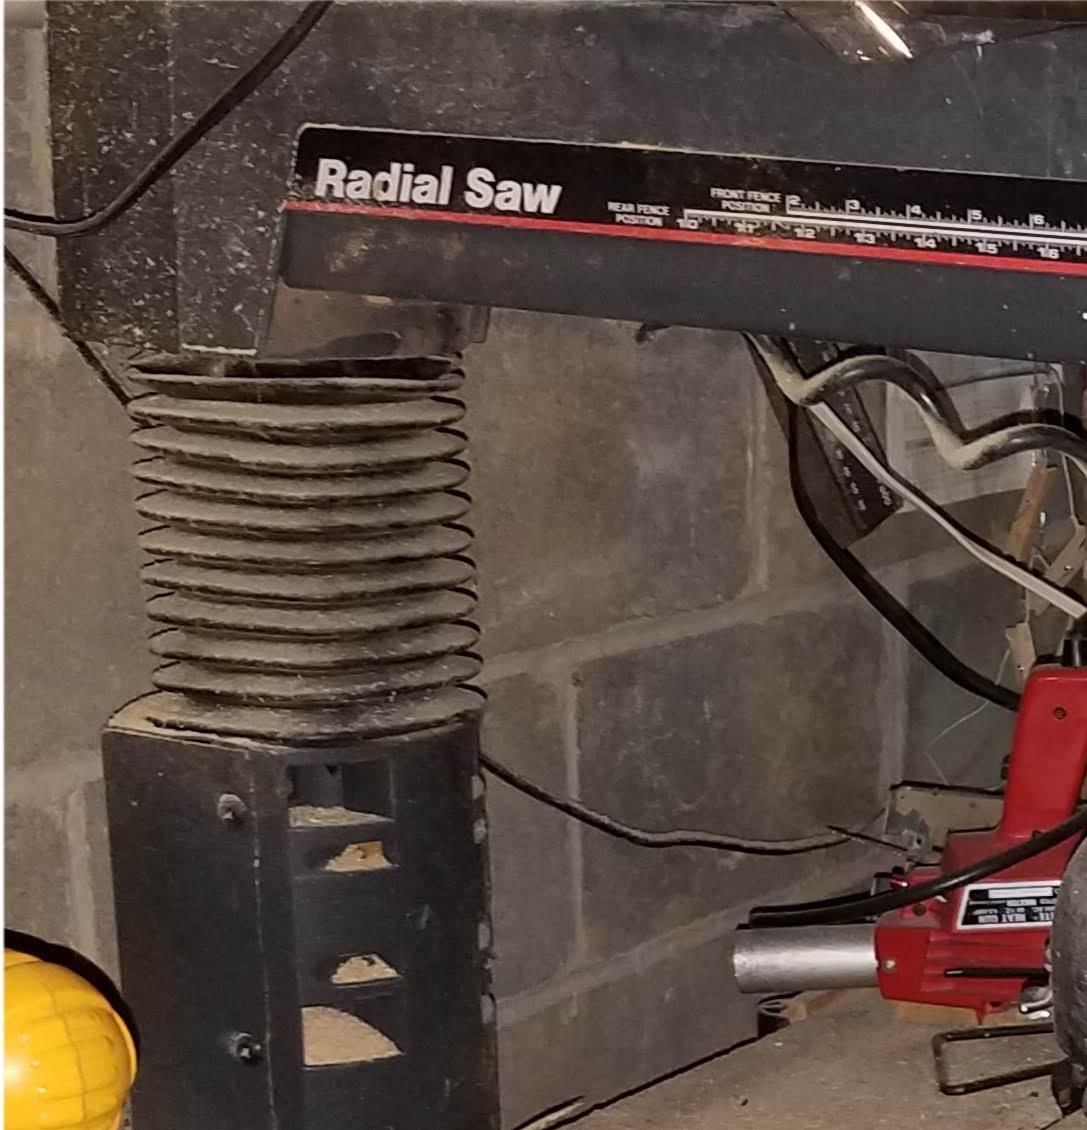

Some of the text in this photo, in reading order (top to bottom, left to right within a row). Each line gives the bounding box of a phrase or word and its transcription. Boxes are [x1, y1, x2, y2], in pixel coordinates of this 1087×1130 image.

[314, 157, 563, 214] Radial Saw
[710, 187, 784, 203] FRONT FENCE
[607, 201, 671, 216] REAR FENCE
[721, 200, 771, 213] POSITION
[789, 195, 801, 206] 2
[849, 199, 860, 210] 3
[911, 205, 922, 215] 4
[972, 209, 983, 220] 5
[1034, 214, 1045, 225] 6
[615, 213, 664, 227] POSITION
[676, 218, 699, 230] 10
[794, 227, 817, 239] 12
[853, 231, 877, 244] 13
[914, 236, 937, 249] 14
[975, 241, 998, 255] 15
[1037, 247, 1060, 260] 16
